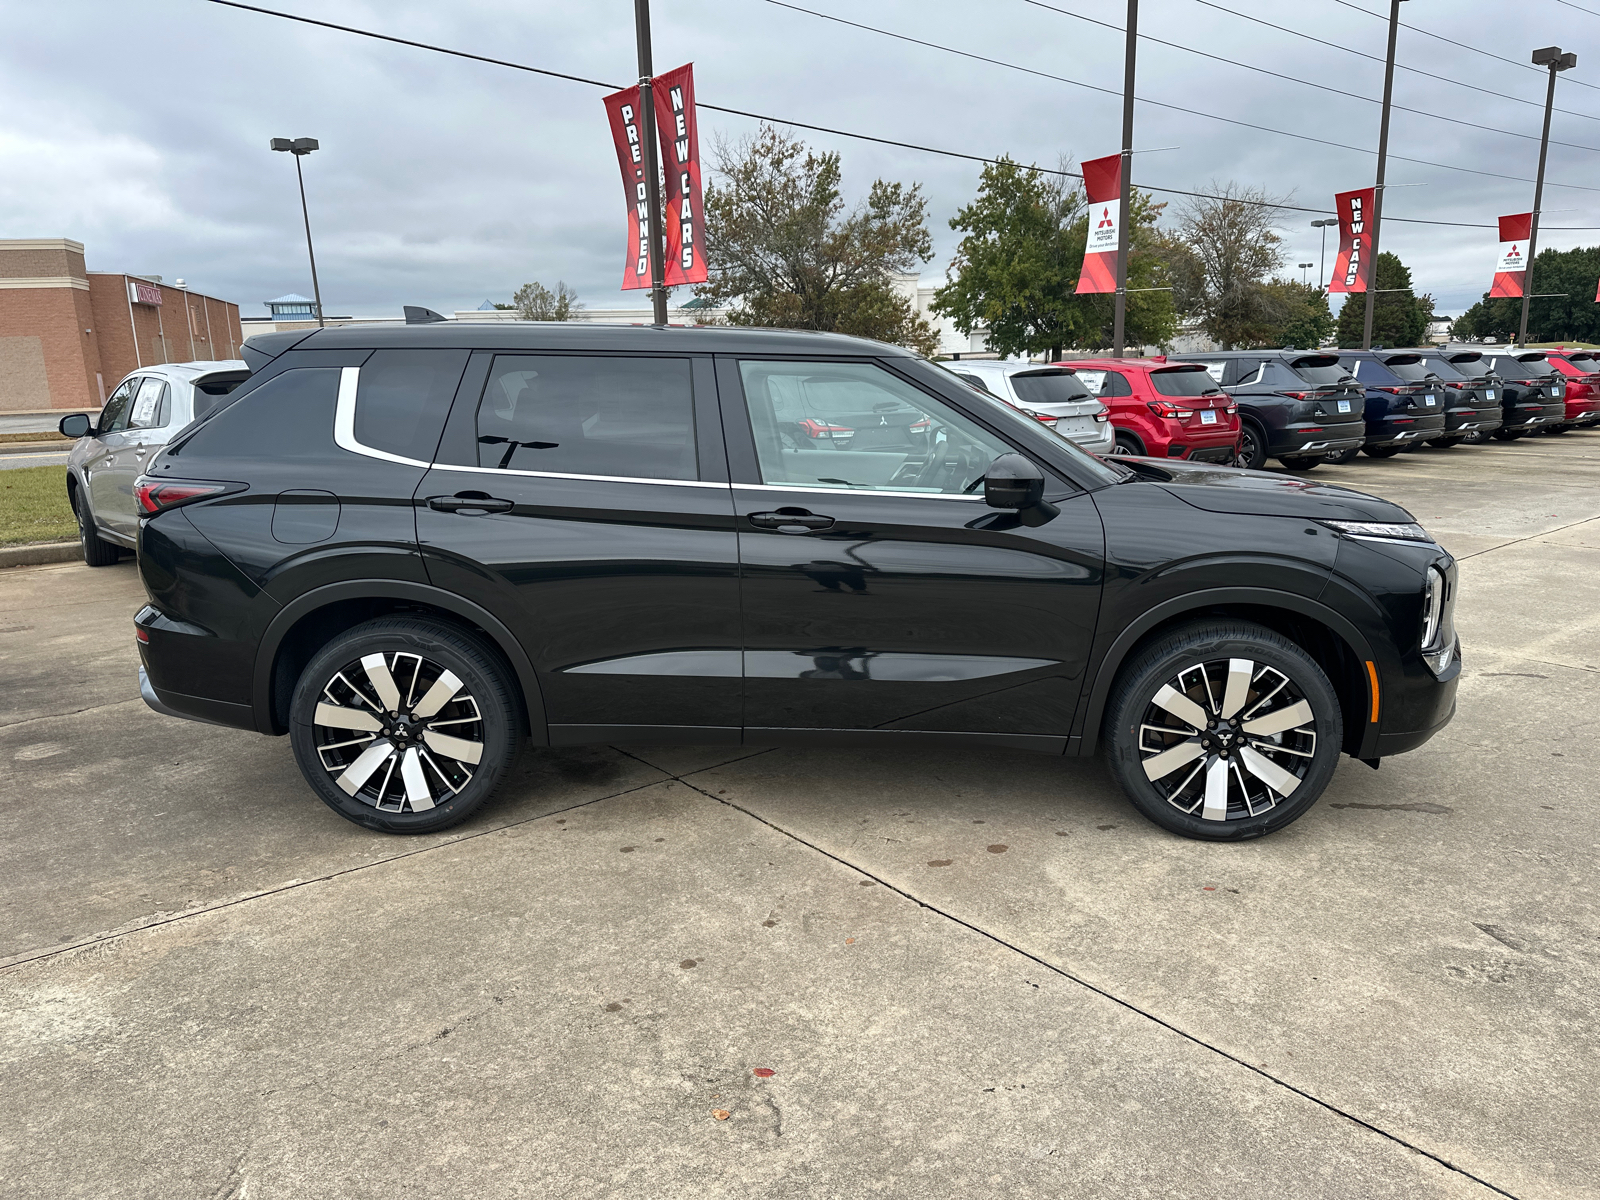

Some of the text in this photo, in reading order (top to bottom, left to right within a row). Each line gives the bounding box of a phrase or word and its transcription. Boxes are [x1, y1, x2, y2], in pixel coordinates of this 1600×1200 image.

[670, 87, 693, 269] NEW CARS
[1094, 228, 1116, 236] MITSUBISHI
[1096, 234, 1113, 242] MOTORS
[1345, 198, 1364, 285] NEW CARS
[138, 285, 163, 304] CINEMAS
[465, 670, 497, 727] NEXEN
